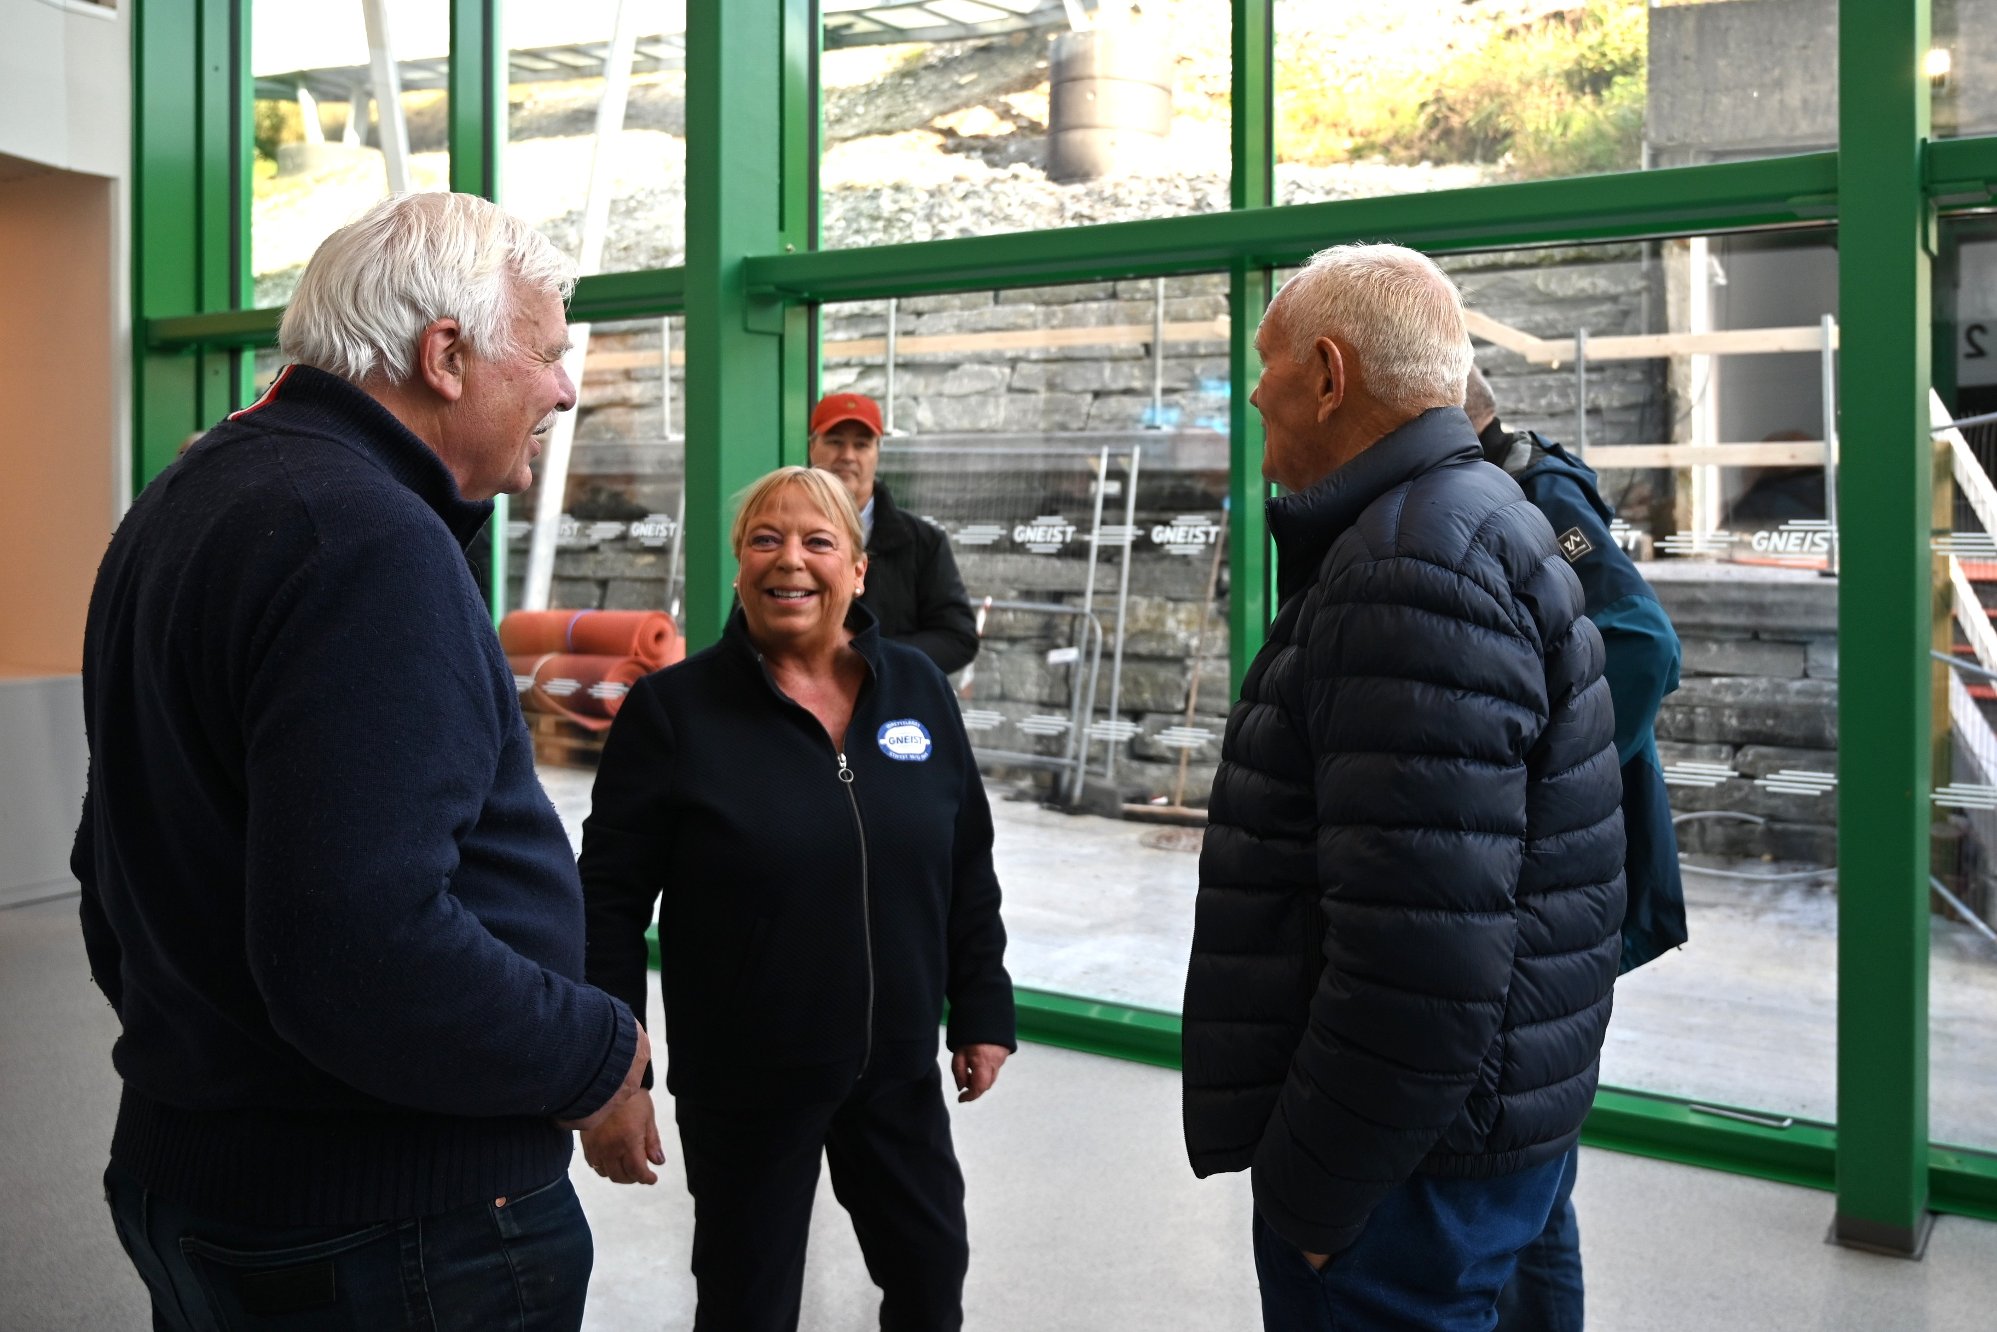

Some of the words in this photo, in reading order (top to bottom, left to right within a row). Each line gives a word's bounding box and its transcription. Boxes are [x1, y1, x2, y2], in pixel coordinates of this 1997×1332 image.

[631, 522, 677, 537] GNEIST
[1013, 525, 1076, 543] GNEIST
[1151, 525, 1220, 543] GNEIST
[888, 735, 923, 745] GNEIST
